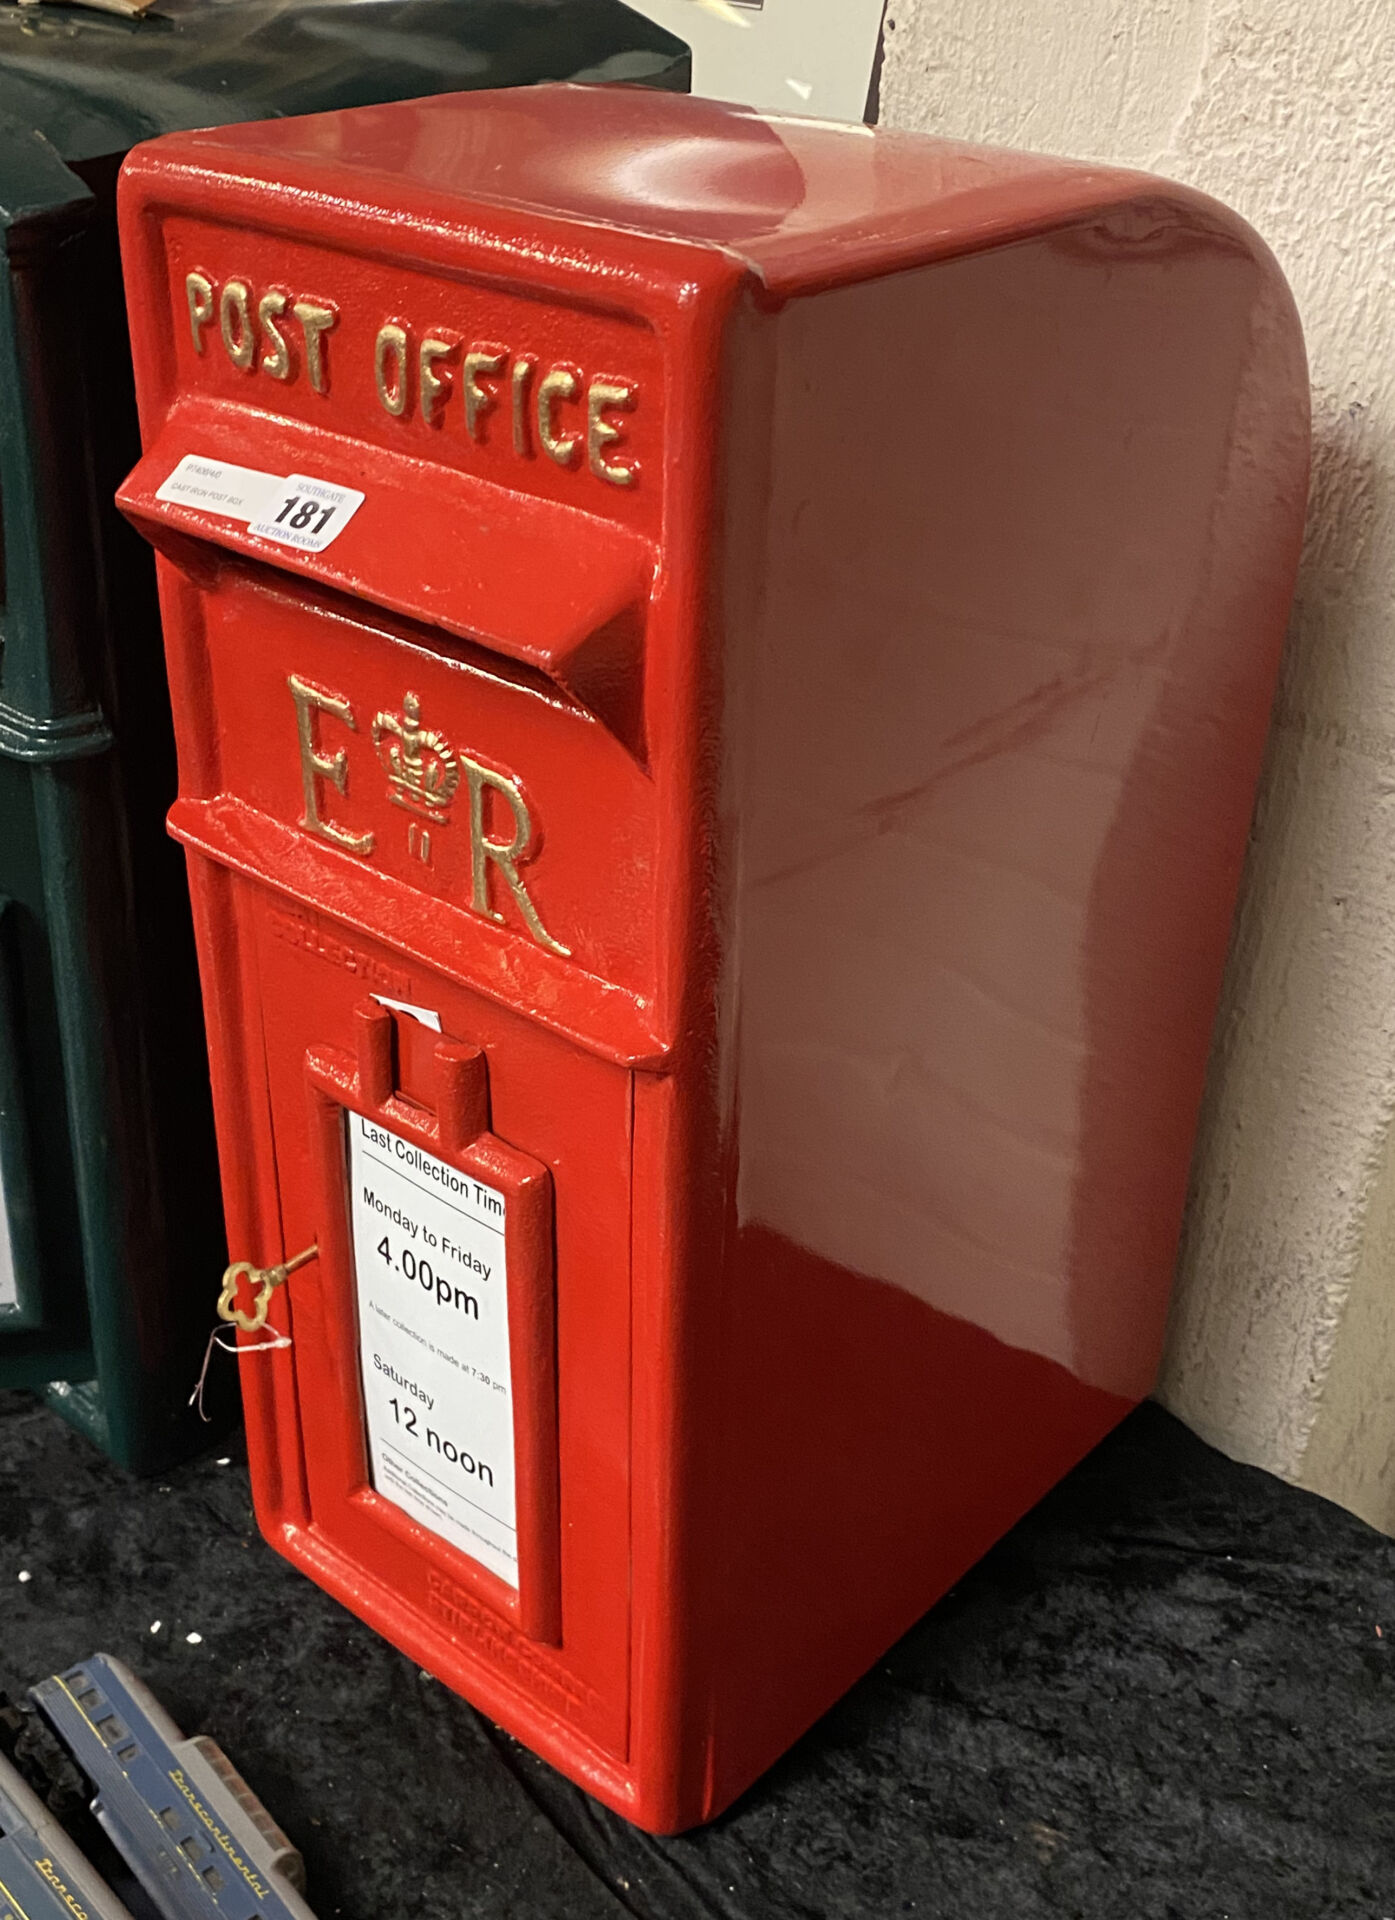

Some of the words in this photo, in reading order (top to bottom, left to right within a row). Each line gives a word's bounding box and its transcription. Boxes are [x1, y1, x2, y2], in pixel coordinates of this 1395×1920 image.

[184, 269, 338, 394] POST
[374, 320, 638, 486] OFFICE
[274, 496, 337, 535] 181
[296, 483, 346, 504] SOUTHGATE
[255, 524, 291, 541] AUCTION
[290, 533, 322, 549] ROOMS
[287, 673, 375, 856] E
[459, 750, 572, 957] R
[361, 1118, 392, 1153] Last
[395, 1140, 469, 1198] Collection
[473, 1184, 506, 1217] Tim
[363, 1187, 419, 1239] Monday
[423, 1226, 437, 1247] to
[442, 1237, 492, 1282] Friday
[376, 1236, 480, 1321] 4.00pm
[373, 1353, 435, 1411] Saturday
[392, 1319, 427, 1347] collection
[437, 1348, 460, 1368] made
[493, 1381, 507, 1396] pm
[389, 1398, 418, 1437] 12
[426, 1427, 494, 1488] noon
